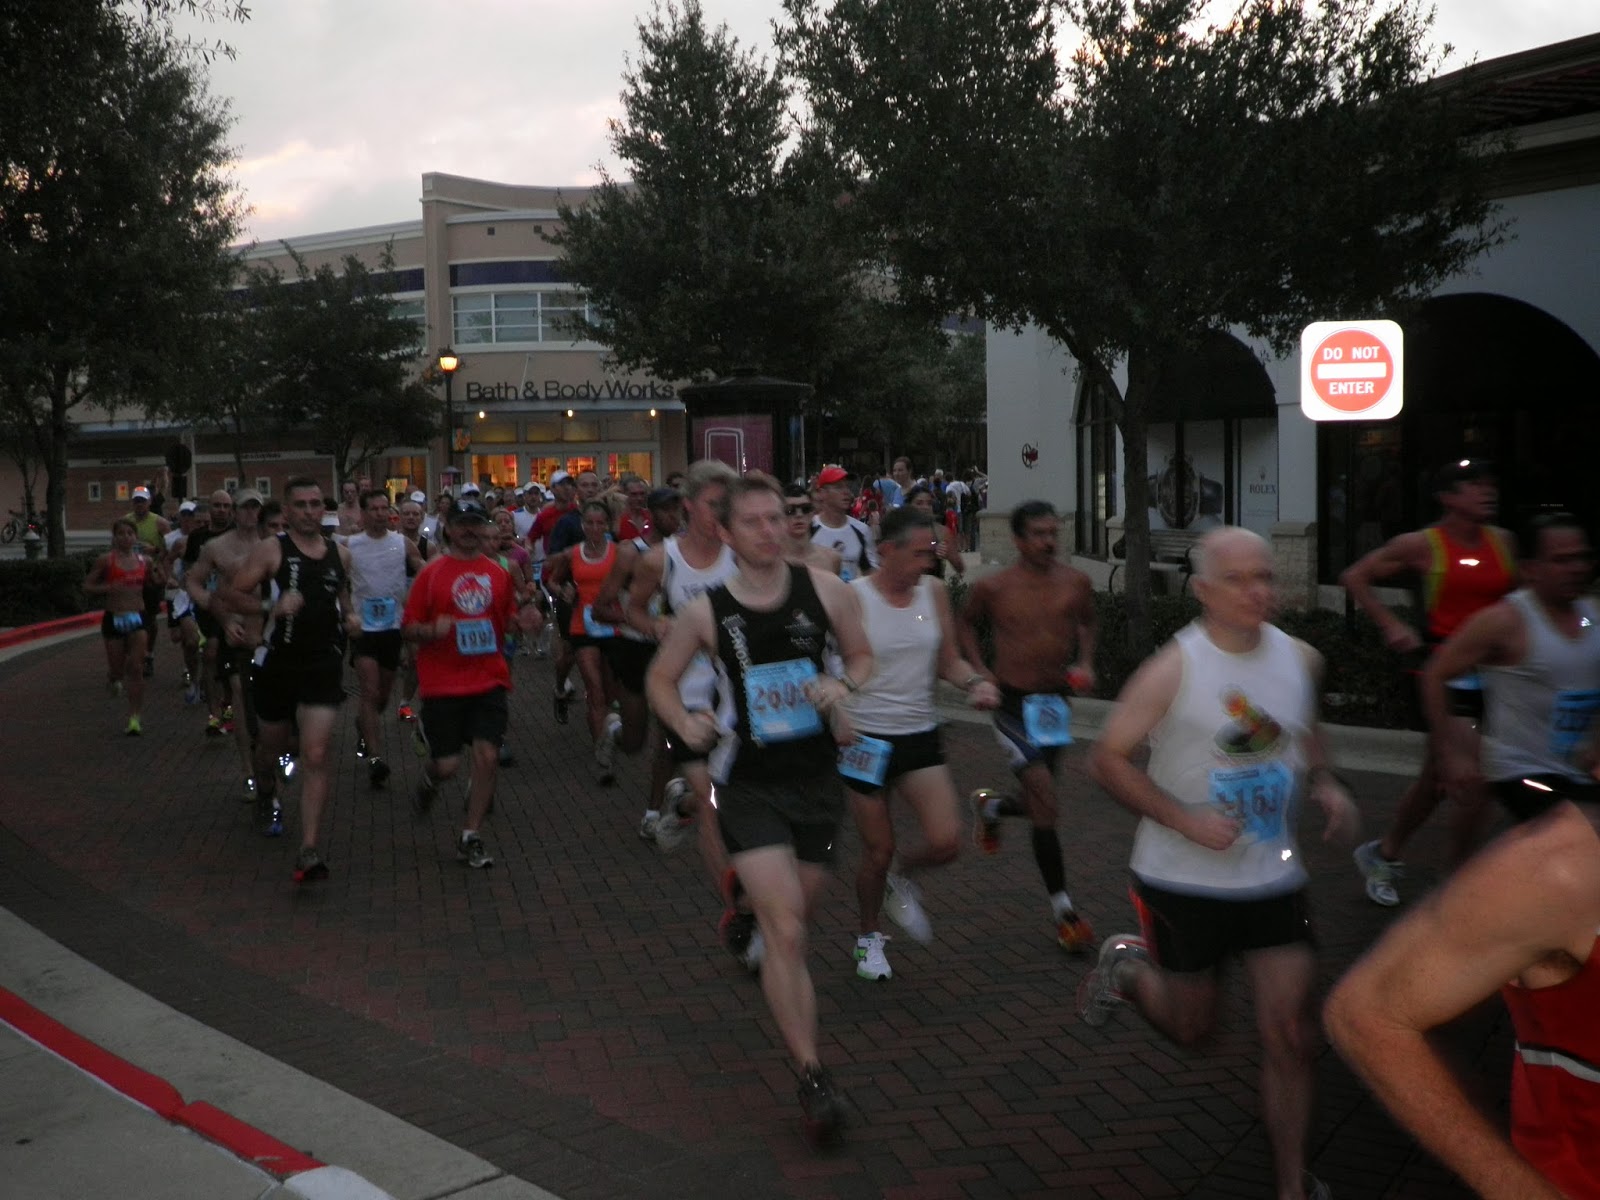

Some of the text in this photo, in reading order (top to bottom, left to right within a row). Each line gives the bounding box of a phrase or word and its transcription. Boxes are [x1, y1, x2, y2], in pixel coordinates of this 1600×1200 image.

[1323, 346, 1380, 360] DO NOT
[466, 379, 675, 403] Bath & Body Works
[1329, 381, 1375, 395] ENTER
[1249, 484, 1276, 495] ROLEX
